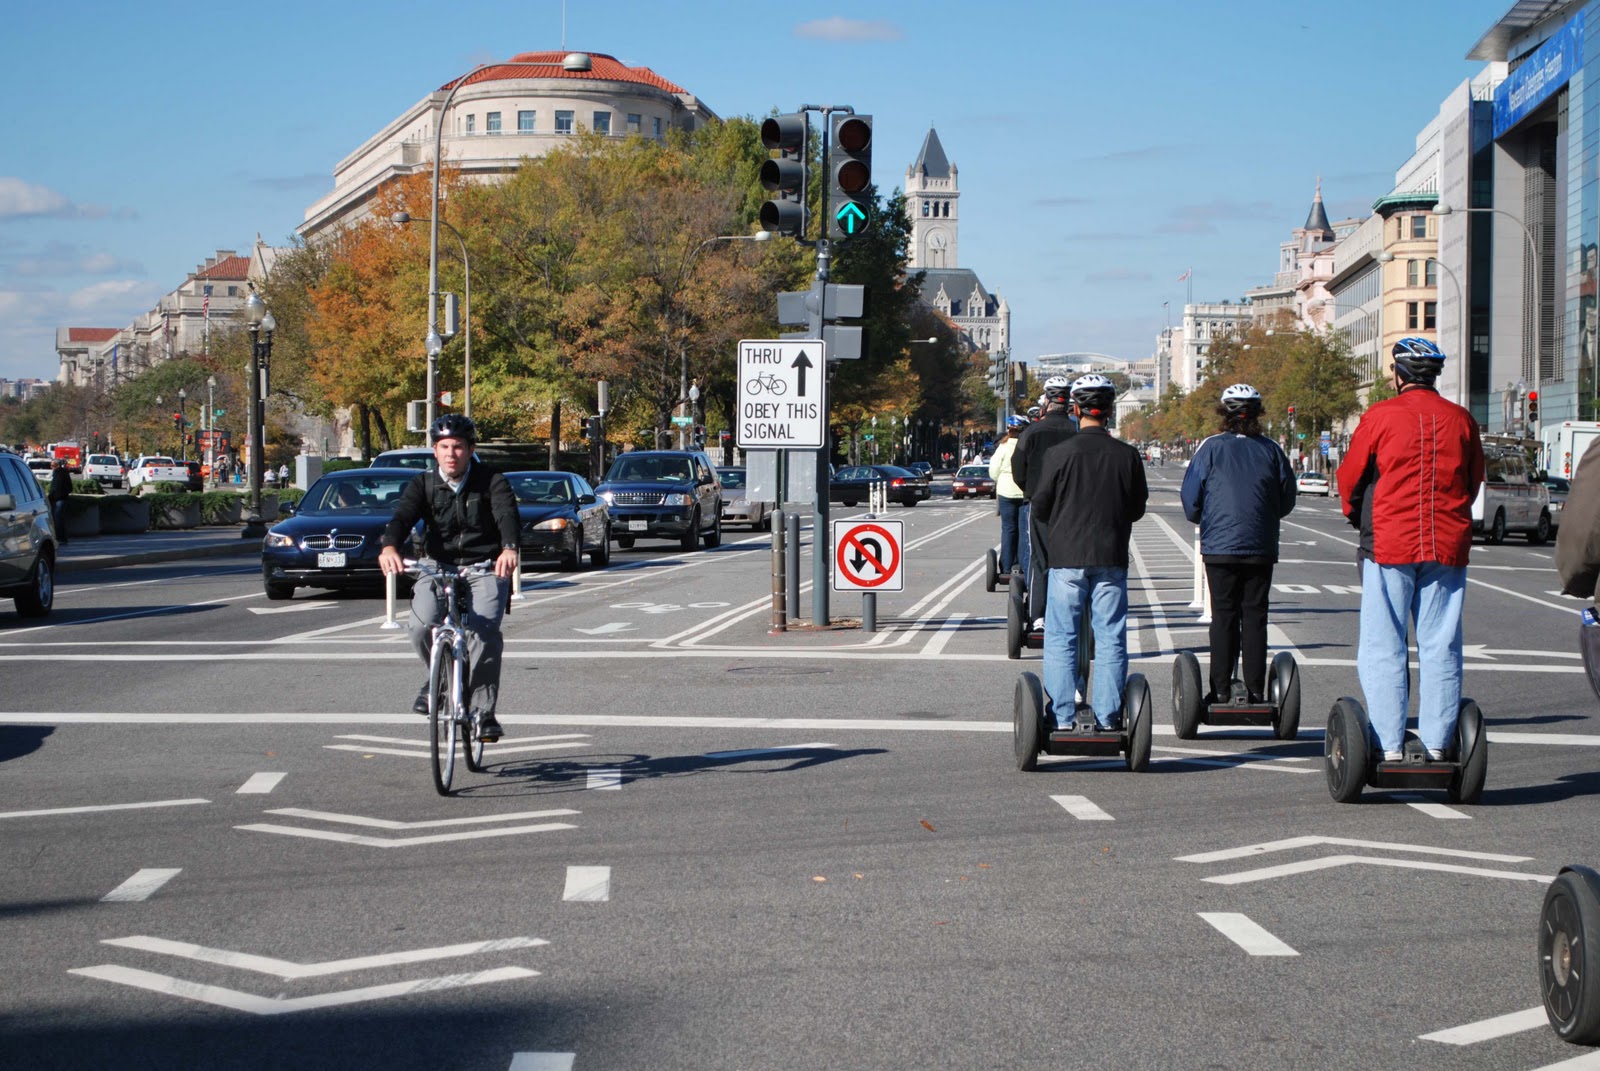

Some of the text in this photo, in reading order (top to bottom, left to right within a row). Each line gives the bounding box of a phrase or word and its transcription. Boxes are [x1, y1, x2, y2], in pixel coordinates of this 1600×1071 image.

[744, 348, 782, 365] THRU
[744, 402, 818, 419] OBEY THIS
[744, 423, 795, 440] SIGNAL
[1271, 583, 1363, 595] ON
